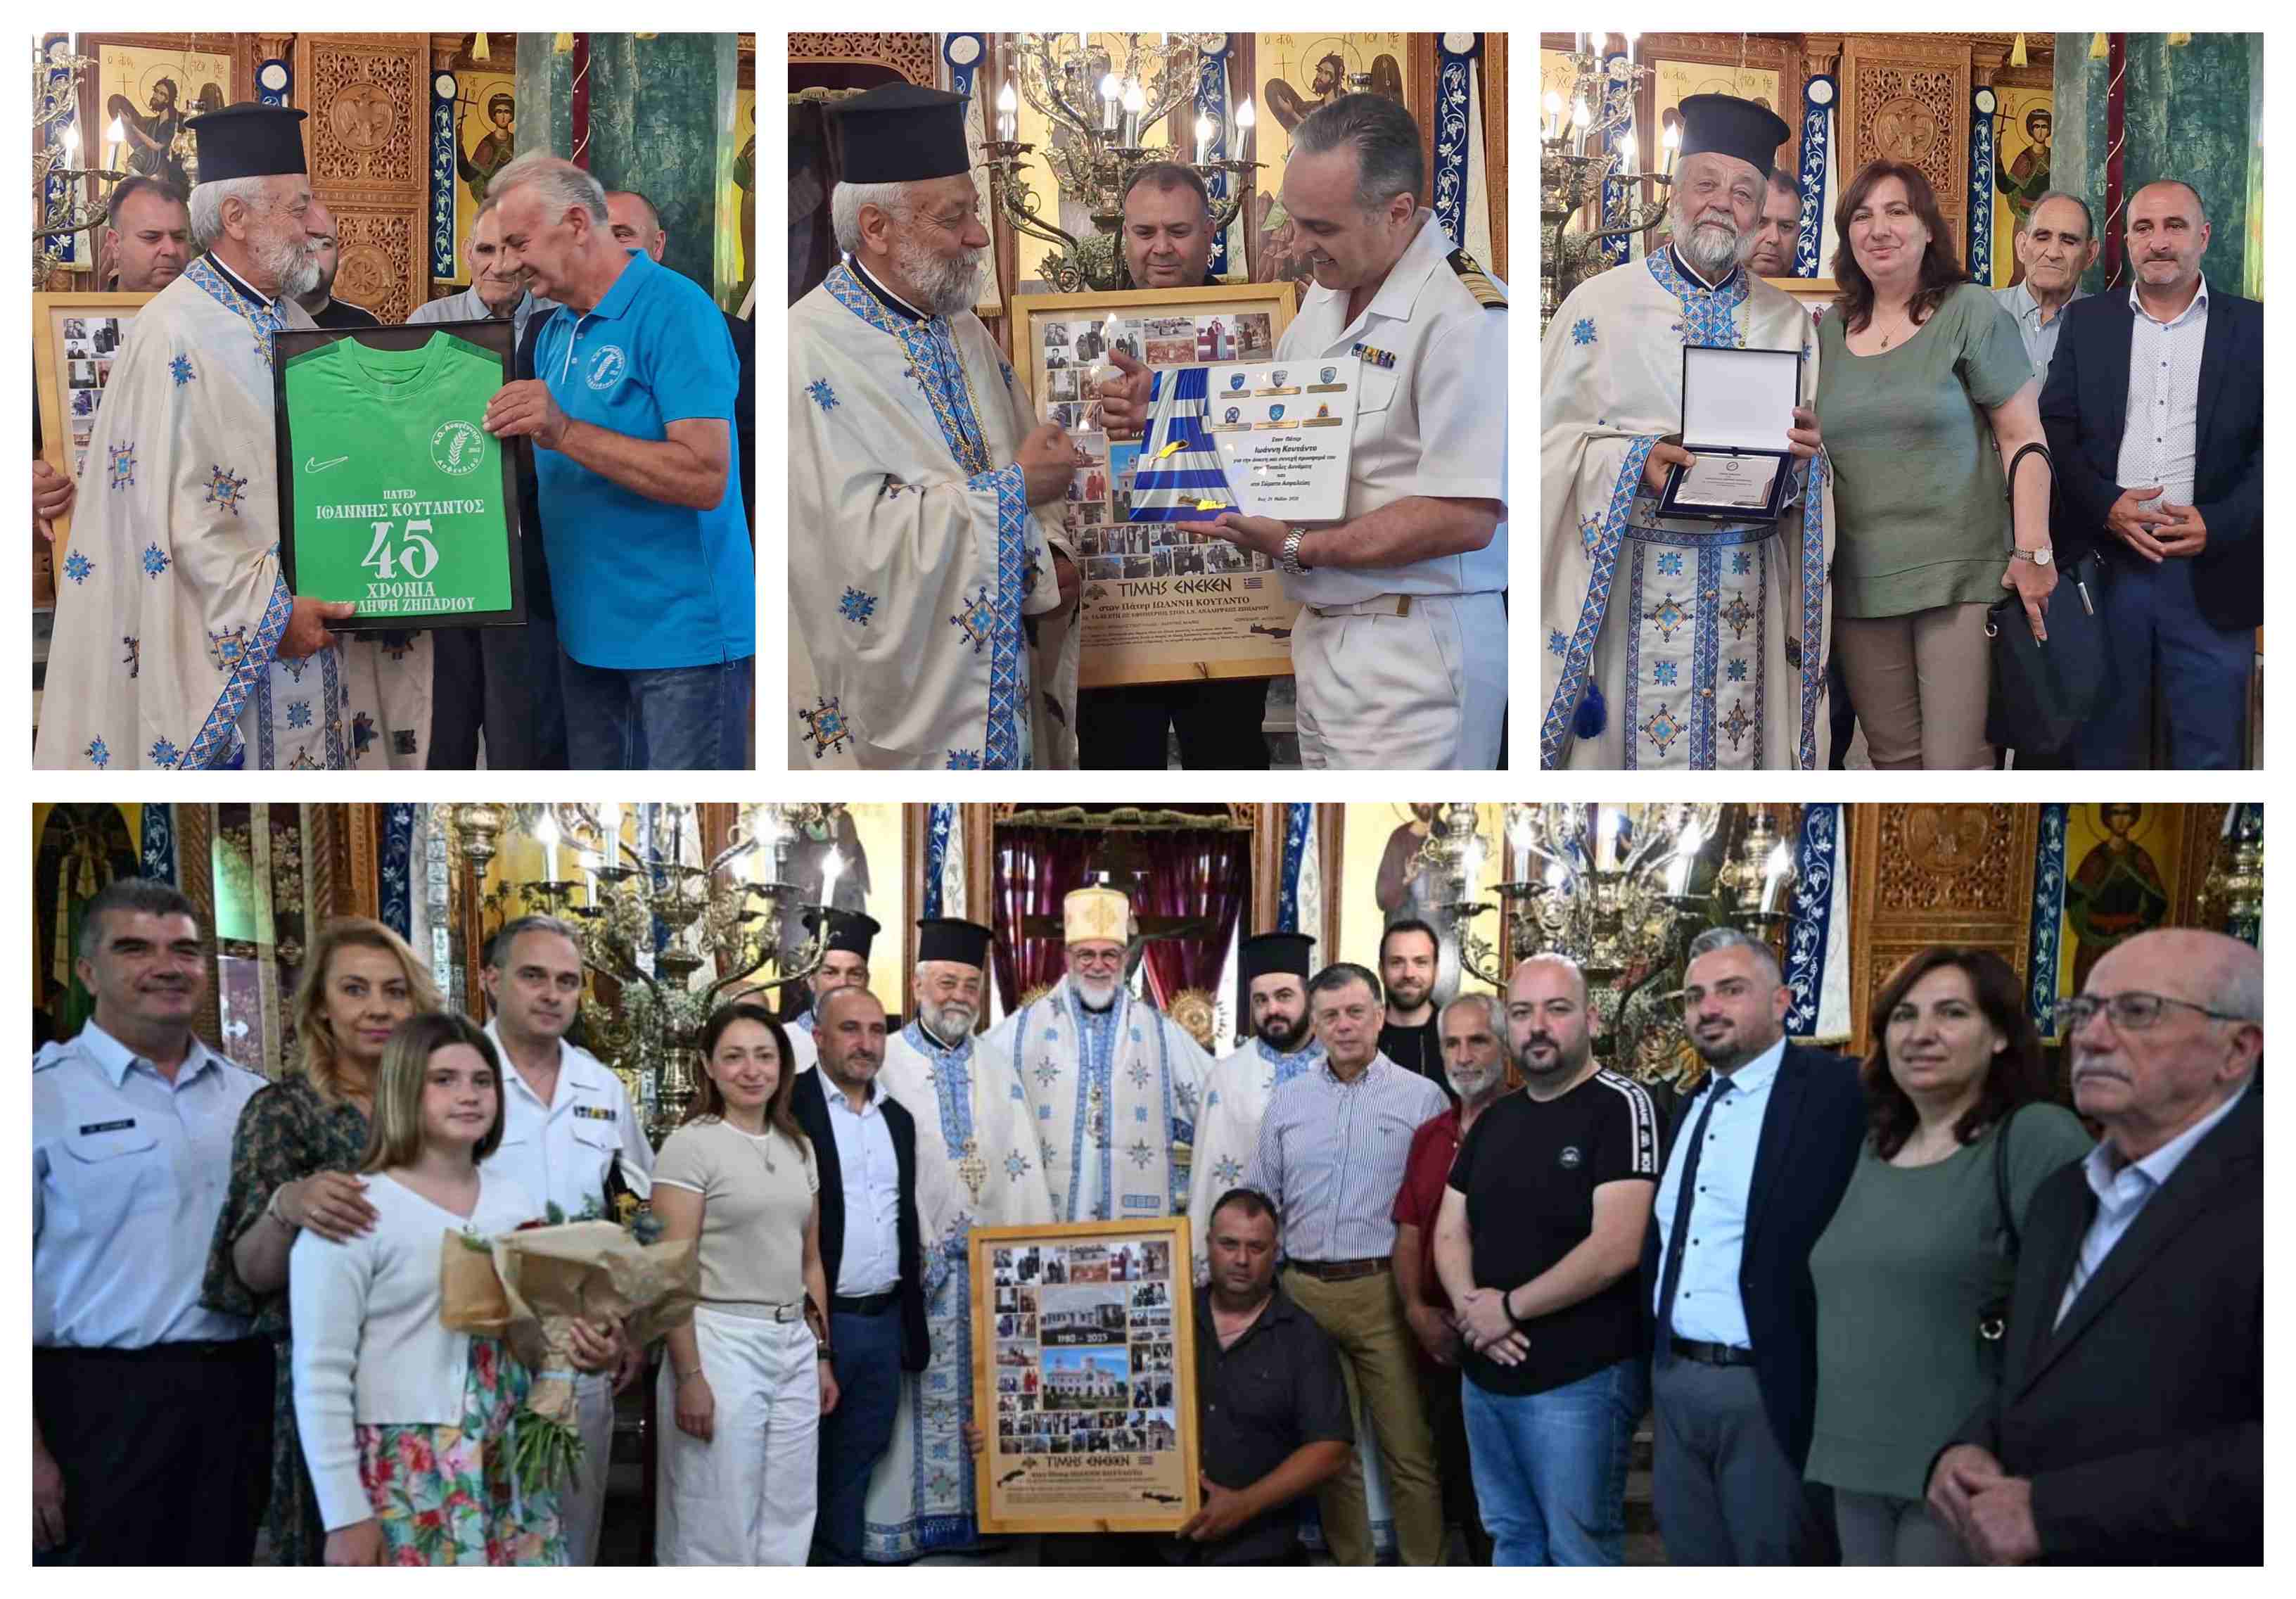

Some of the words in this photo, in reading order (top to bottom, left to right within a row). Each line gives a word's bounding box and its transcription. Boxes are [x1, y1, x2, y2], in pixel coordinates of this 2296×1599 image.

[383, 489, 416, 499] ΠΑΤΕΡ
[316, 504, 388, 519] ΙΩΑΝΝΗΣ
[391, 499, 484, 517] ΚΟΥΤΑΝΤΟΣ
[360, 518, 439, 579] 45
[365, 581, 436, 599] ΧΡΟΝΙΑ
[1174, 578, 1232, 594] ΕΝΕΚΕΝ
[402, 597, 475, 611] ΖΗΠΑΡΙΟΥ
[1153, 599, 1193, 608] ΙΩΑΝΝΗ
[1196, 596, 1250, 606] ΚΟΥΤΑΝΤΟ
